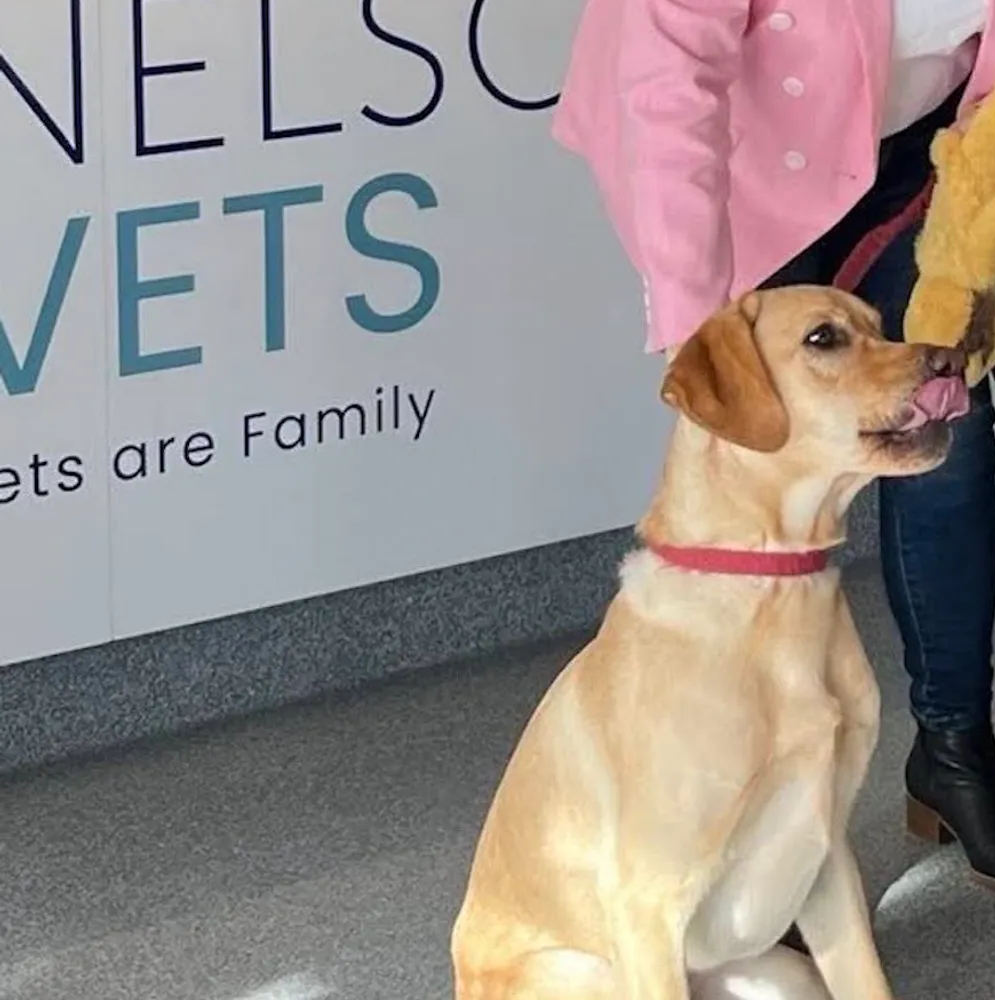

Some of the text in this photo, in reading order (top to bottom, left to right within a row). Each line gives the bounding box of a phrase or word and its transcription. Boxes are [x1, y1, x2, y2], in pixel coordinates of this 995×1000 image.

[0, 172, 441, 397] VETS
[0, 384, 436, 503] ets are Family
